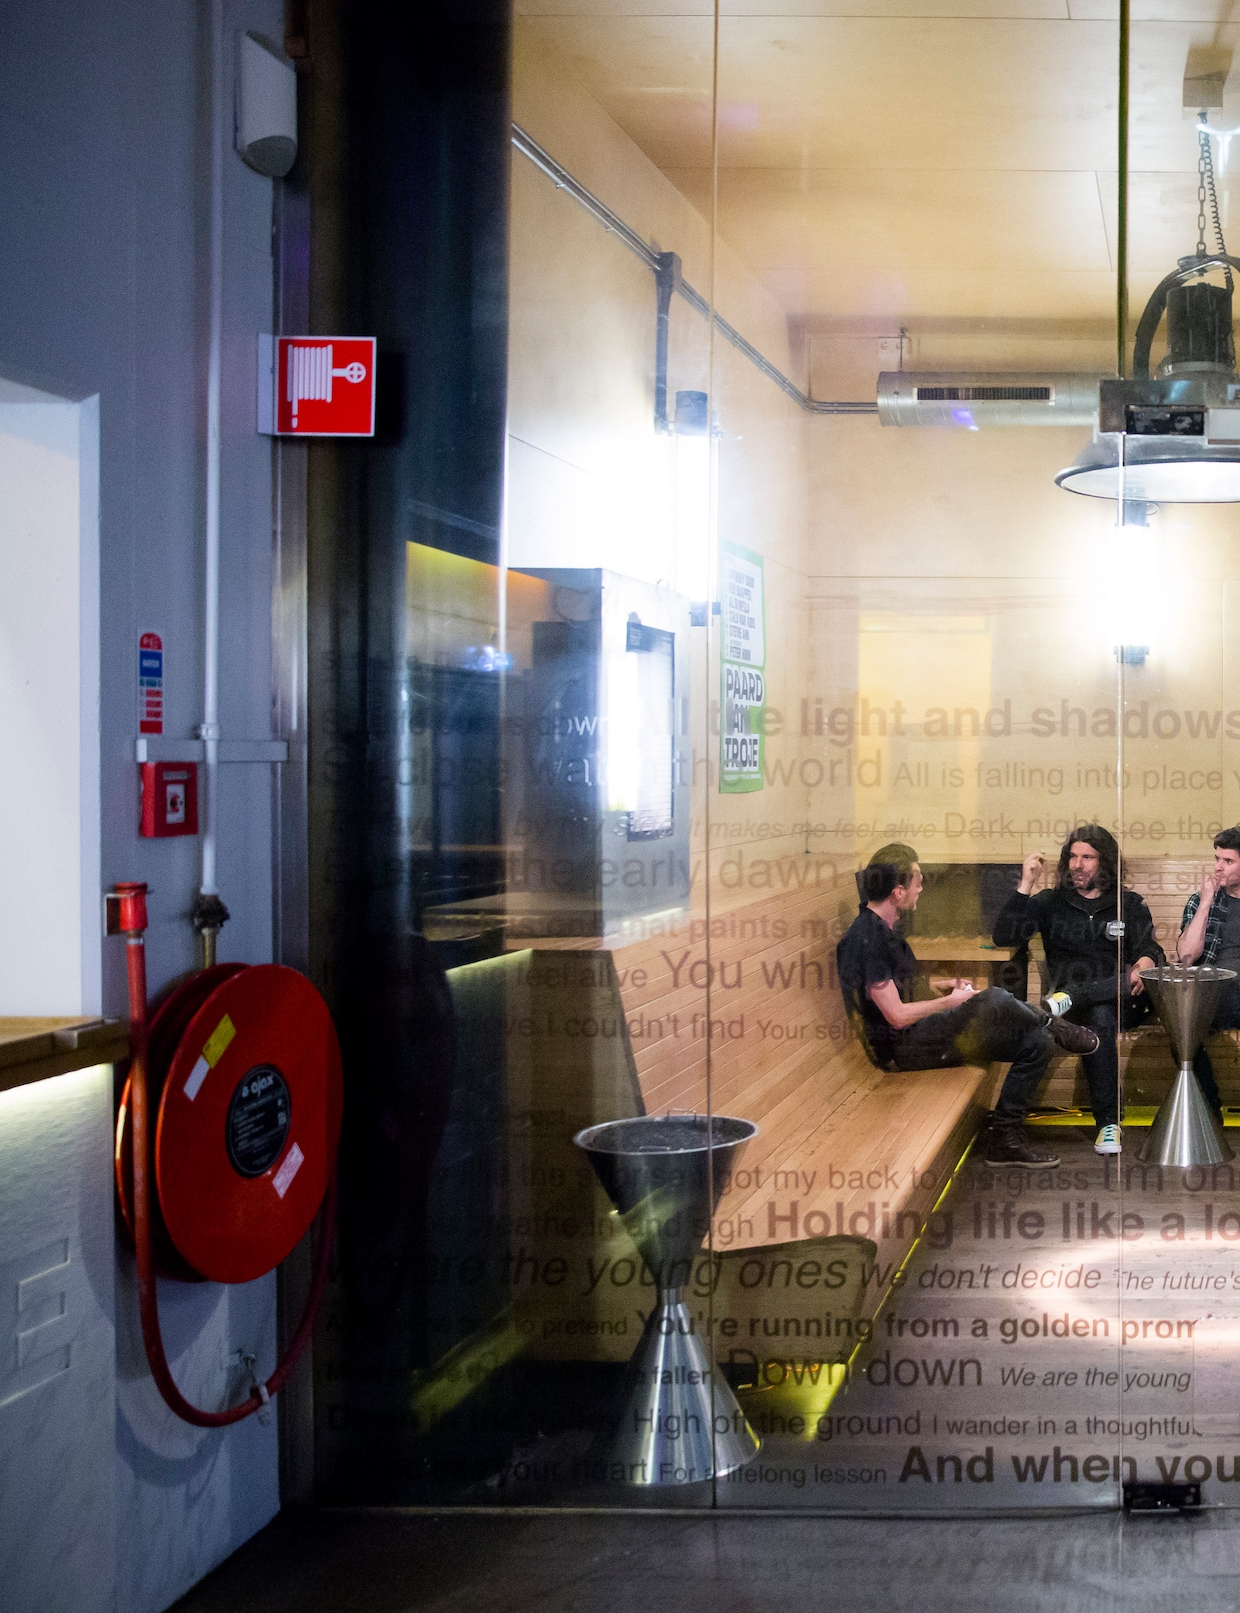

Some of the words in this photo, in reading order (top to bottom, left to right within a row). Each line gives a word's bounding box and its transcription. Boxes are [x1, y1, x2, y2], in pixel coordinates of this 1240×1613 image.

[725, 667, 763, 701] PAARD
[800, 698, 907, 746] light
[923, 699, 1011, 736] and
[725, 737, 758, 768] TROJE
[762, 749, 881, 787] world
[893, 763, 928, 787] All
[942, 762, 964, 787] is
[975, 762, 1064, 794] falling
[1076, 764, 1130, 790] into
[1142, 765, 1223, 795] place
[709, 819, 784, 838] makes
[792, 822, 827, 837] me
[834, 819, 878, 837] feel
[884, 819, 937, 837] alive
[944, 812, 1014, 838] Dark
[1178, 816, 1216, 842] the
[600, 850, 700, 897] early
[720, 850, 837, 888] dawn
[689, 914, 788, 944] paints
[661, 951, 742, 989] You
[564, 1012, 681, 1038] couldn't
[689, 1014, 745, 1039] find
[757, 1019, 807, 1041] Your
[775, 1170, 817, 1193] my
[828, 1164, 899, 1190] back
[912, 1166, 937, 1190] to
[1007, 1170, 1089, 1196] grass
[768, 1201, 954, 1249] Holding
[973, 1202, 1045, 1239] life
[1062, 1202, 1144, 1240] like
[1161, 1213, 1185, 1240] a
[582, 1256, 722, 1296] young
[739, 1258, 848, 1289] ones
[861, 1262, 907, 1288] We
[918, 1263, 995, 1289] don't
[1002, 1263, 1101, 1289] decide
[1114, 1269, 1154, 1291] The
[542, 1315, 627, 1338] pretend
[636, 1309, 739, 1338] You're
[749, 1312, 873, 1343] running
[887, 1312, 959, 1338] from
[971, 1317, 989, 1338] a
[999, 1313, 1110, 1343] golden
[729, 1349, 850, 1387] Down
[867, 1350, 982, 1387] down
[1001, 1368, 1035, 1386] We
[1042, 1369, 1077, 1386] are
[1084, 1366, 1119, 1386] the
[1122, 1371, 1192, 1392] young
[635, 1412, 700, 1440] High
[817, 1410, 921, 1441] ground
[933, 1416, 937, 1434] I
[946, 1415, 1030, 1435] wander
[1038, 1414, 1056, 1434] in
[1065, 1419, 1078, 1434] a
[814, 1463, 887, 1483] lesson
[898, 1446, 993, 1483] And
[1011, 1446, 1138, 1483] when
